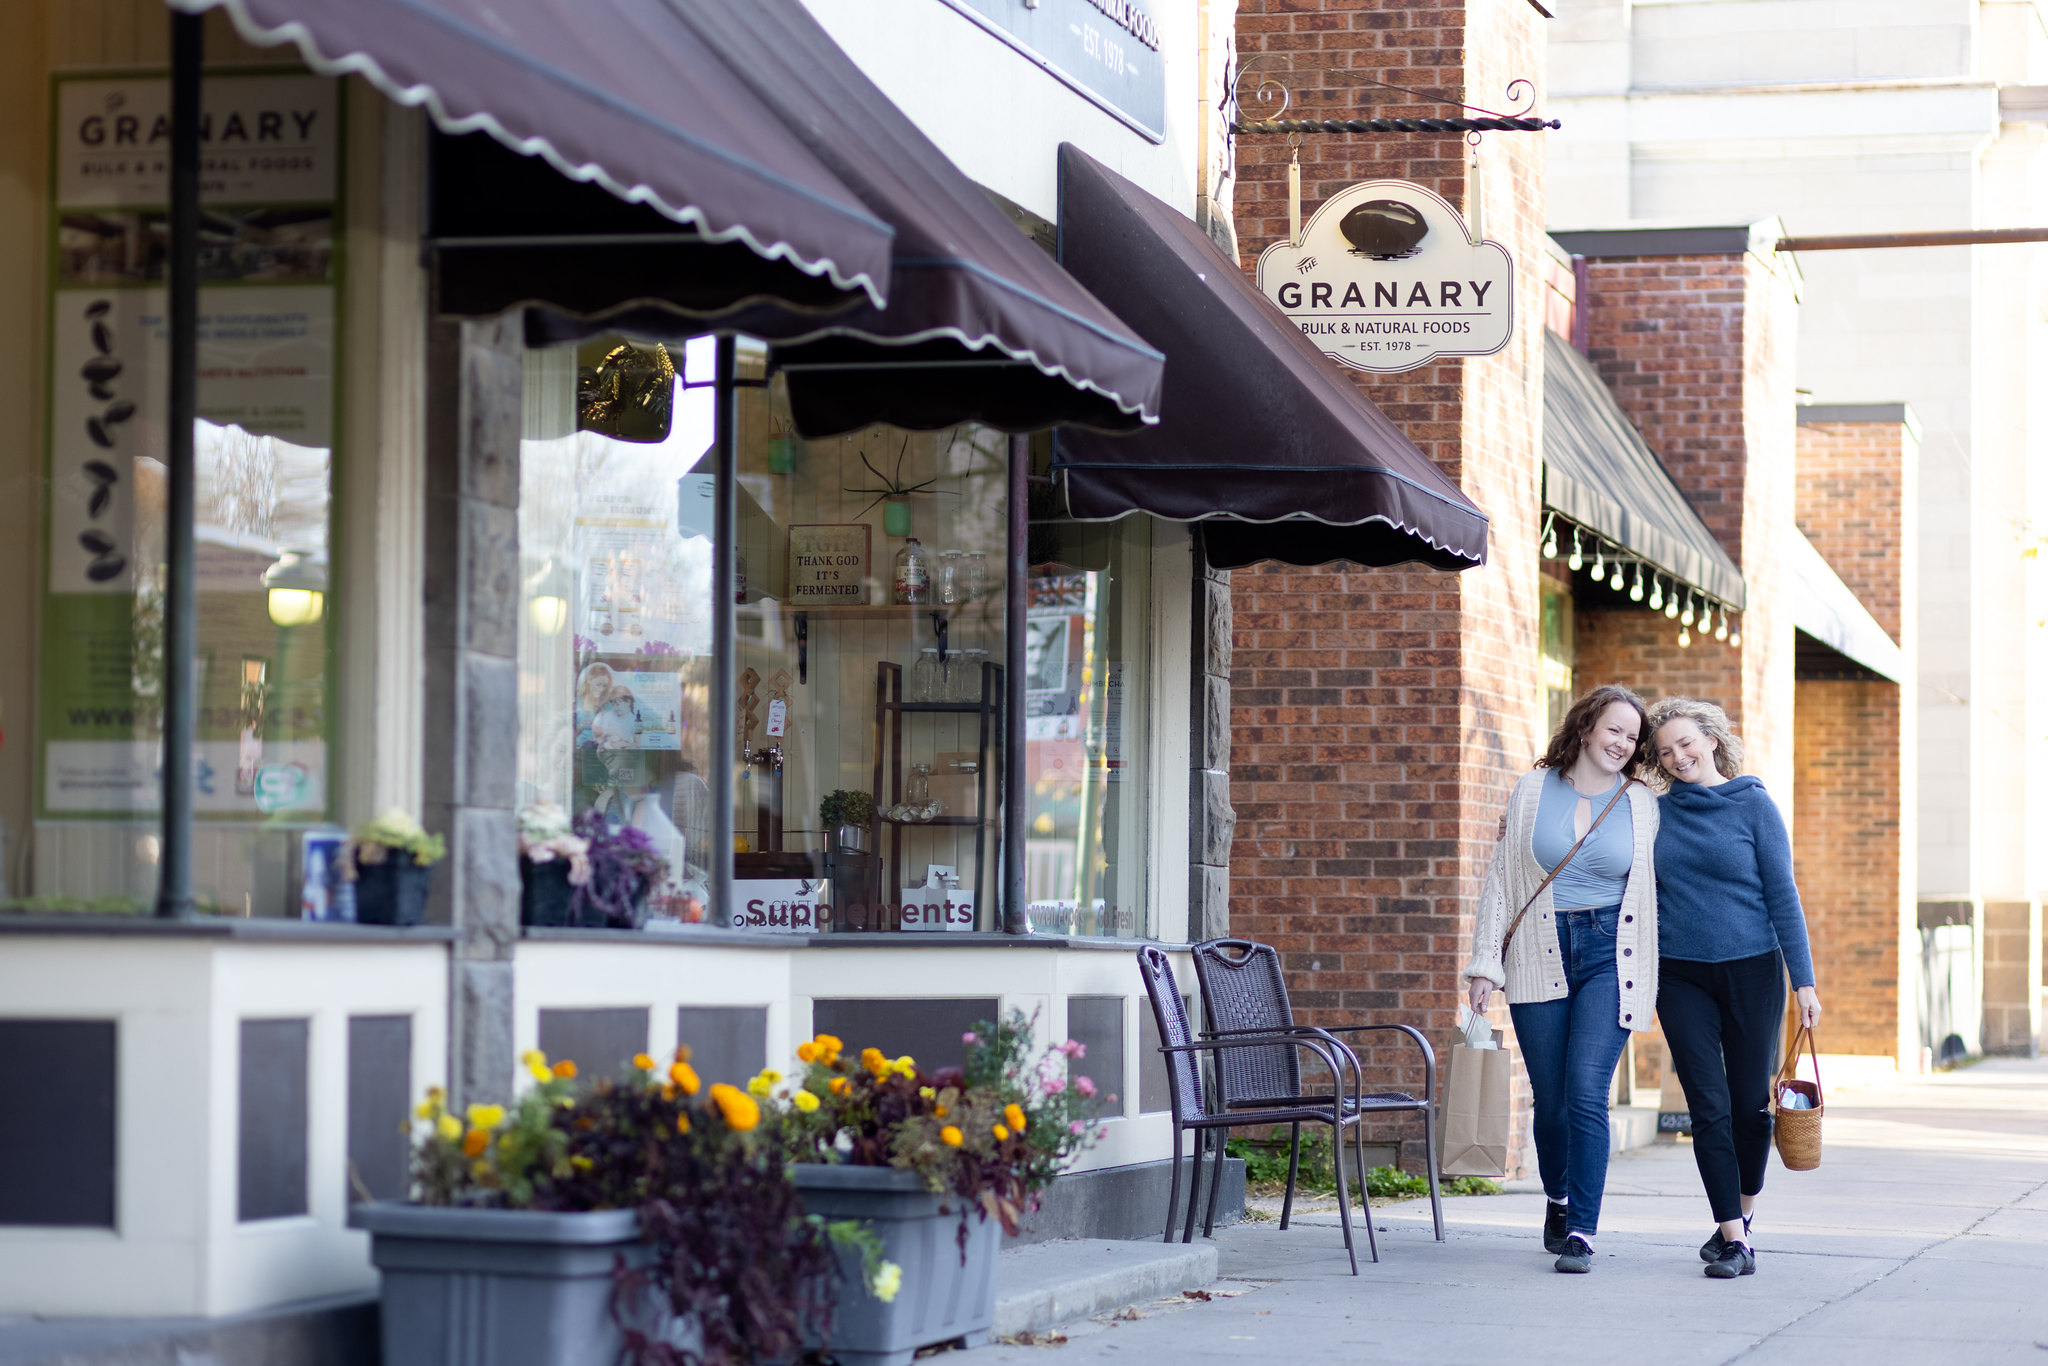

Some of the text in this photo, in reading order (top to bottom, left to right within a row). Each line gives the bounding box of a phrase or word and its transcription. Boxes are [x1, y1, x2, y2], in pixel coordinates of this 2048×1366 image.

[1083, 23, 1124, 76] EST. 1978
[1297, 257, 1319, 275] THE
[1277, 280, 1492, 308] GRANARY
[1301, 321, 1471, 334] BULK & NATURAL FOODS
[1360, 341, 1411, 351] EST. 1978
[797, 555, 859, 566] THANK GOD
[816, 570, 839, 580] IT'S
[796, 585, 859, 595] FERMENTED
[733, 914, 812, 927] OMBUCHA
[747, 899, 973, 929] Supplements
[1112, 905, 1133, 930] Fresh
